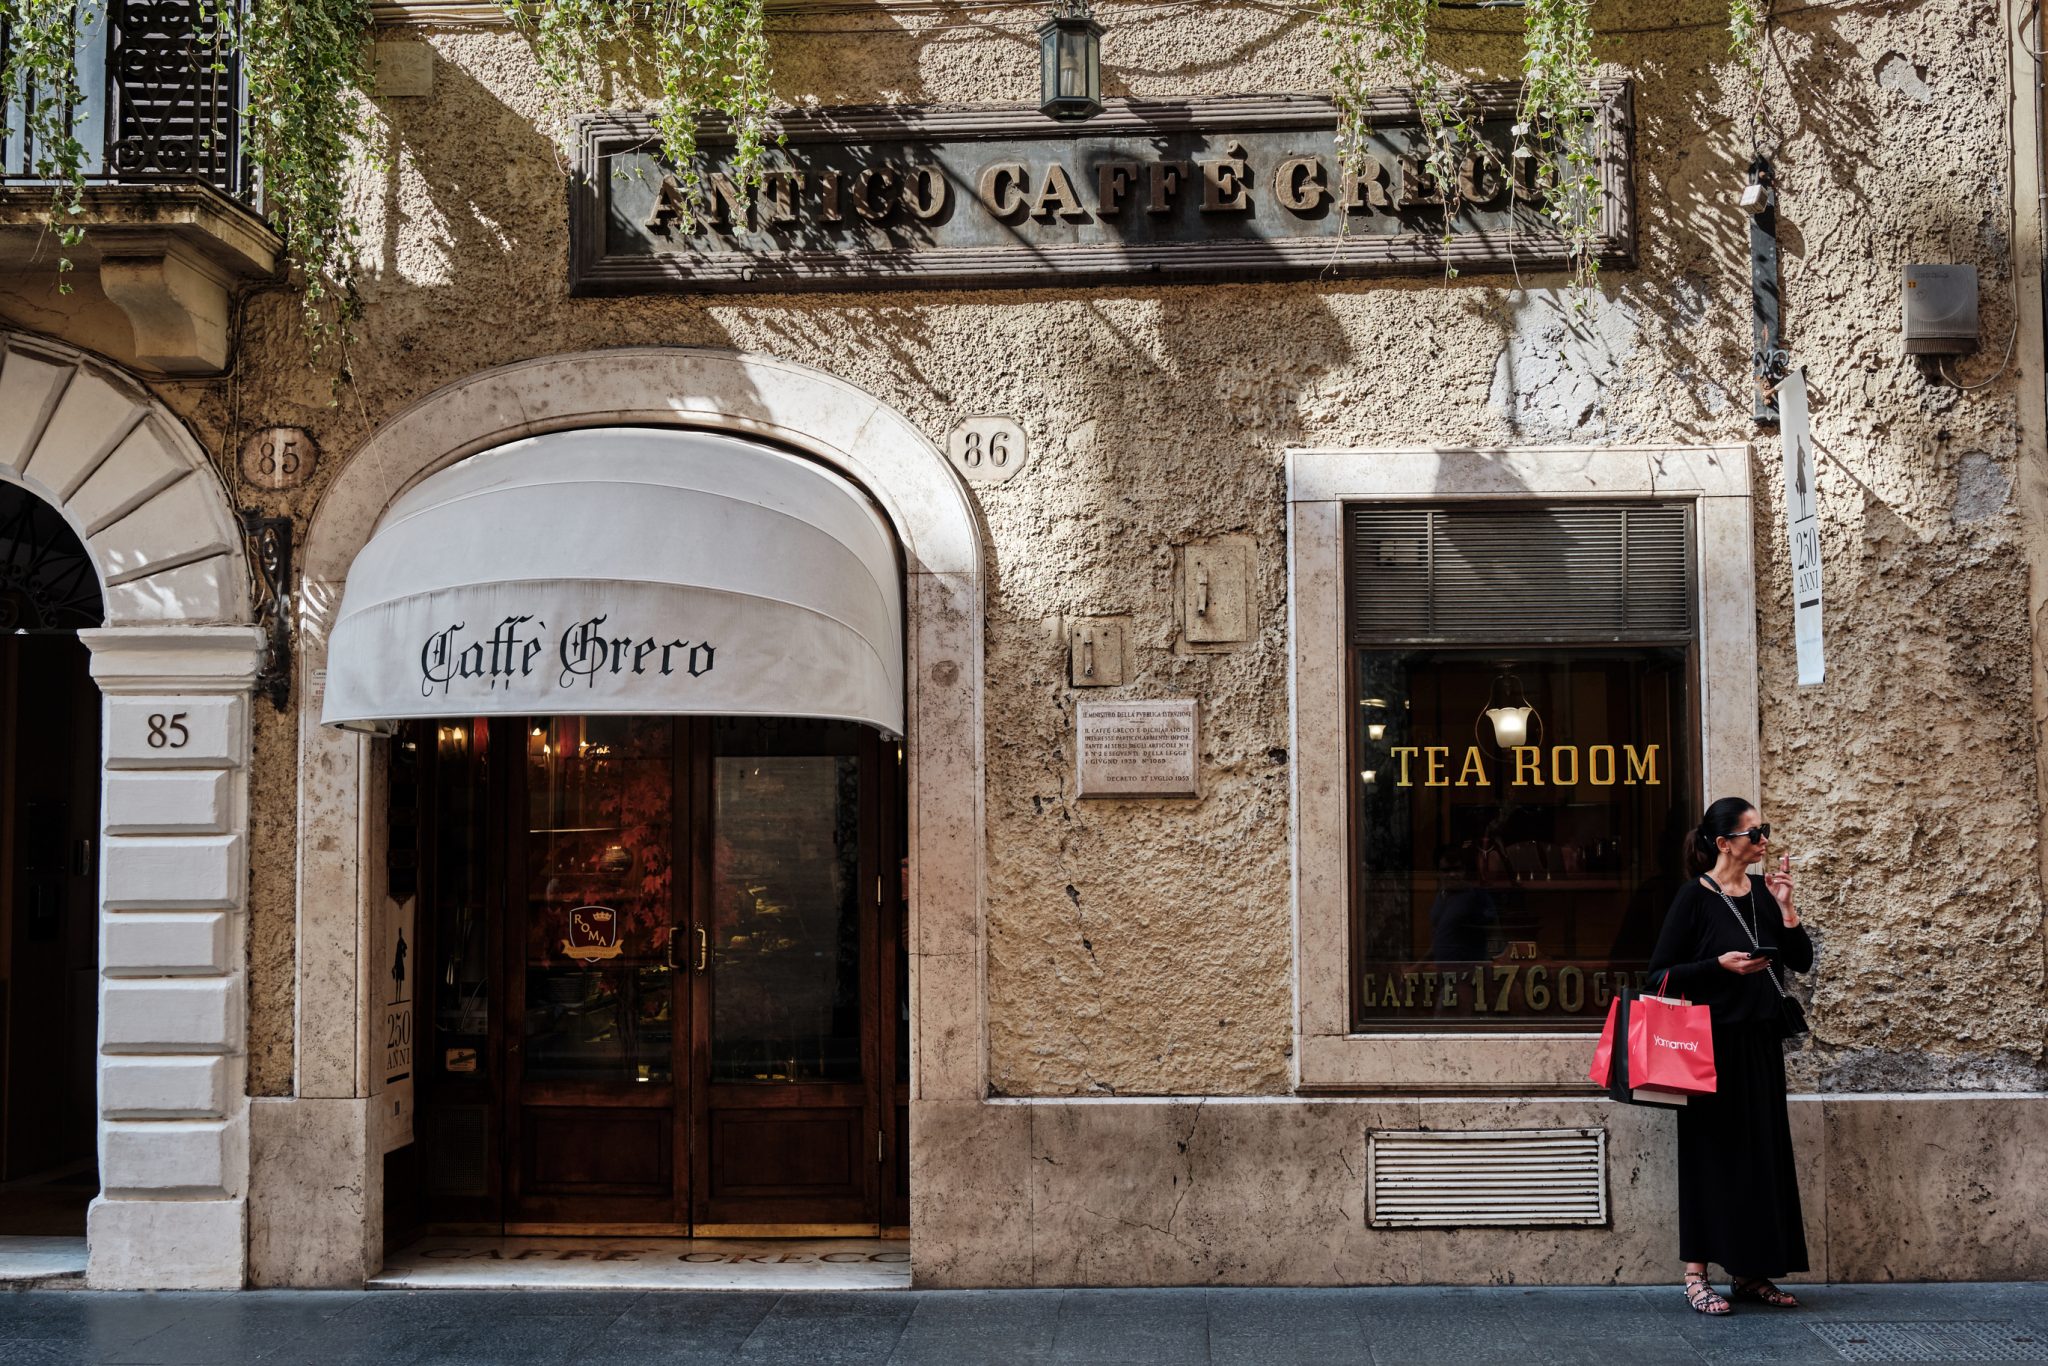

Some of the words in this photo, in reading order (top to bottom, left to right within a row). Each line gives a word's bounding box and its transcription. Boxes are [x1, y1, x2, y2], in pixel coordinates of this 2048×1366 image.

[645, 165, 946, 228] ANTICO
[1275, 151, 1555, 211] GRECO
[260, 442, 299, 475] 85
[964, 431, 1009, 468] 86
[1796, 527, 1817, 570] 250
[1798, 570, 1819, 594] ANNI
[421, 614, 547, 697] Caffè
[559, 613, 717, 688] Greco
[147, 711, 189, 749] 85
[1390, 746, 1491, 787] TEA
[1511, 745, 1661, 786] ROOM
[574, 913, 607, 946] ROMA
[1472, 965, 1585, 1014] 1760
[387, 1010, 411, 1049] 250
[1653, 1033, 1699, 1053] Yamamay
[387, 1048, 410, 1070] ANNI
